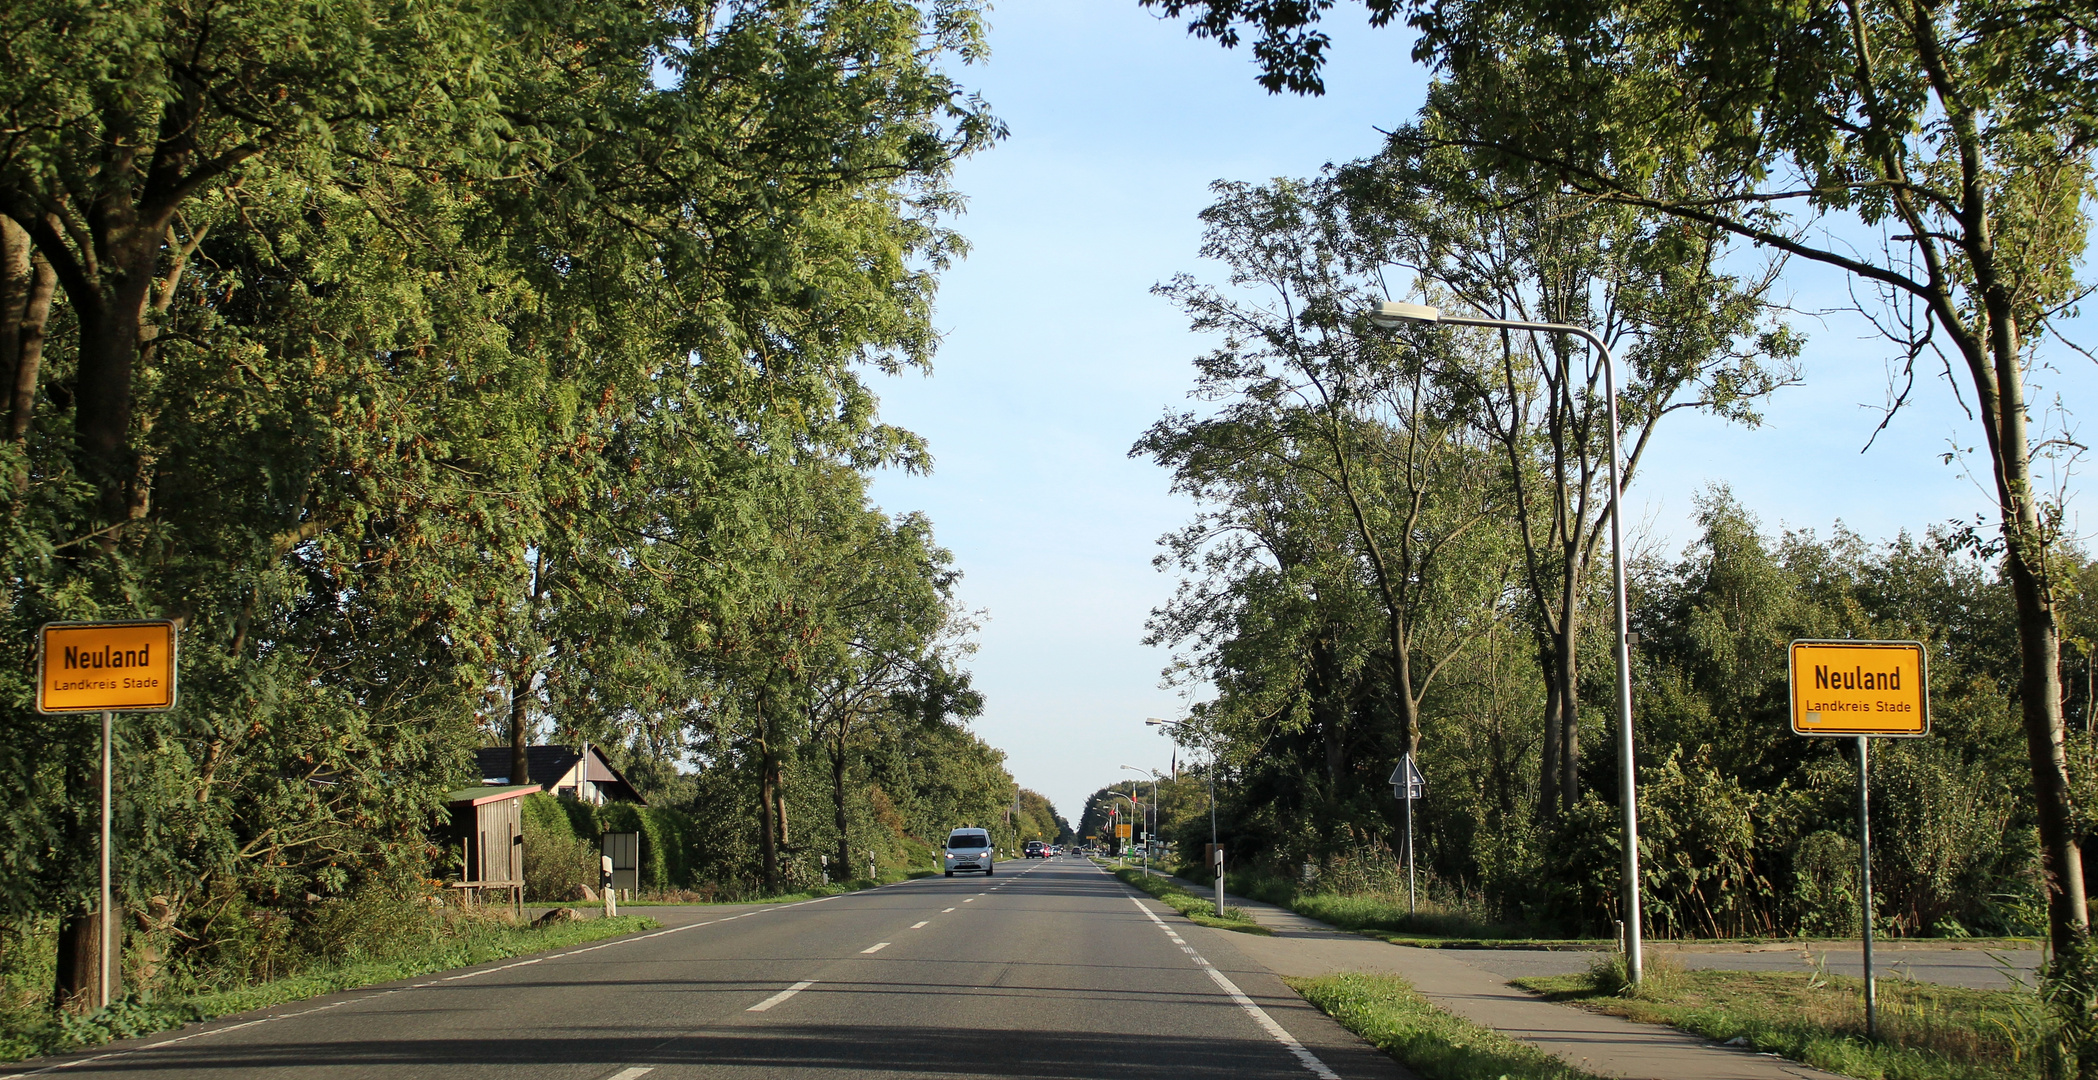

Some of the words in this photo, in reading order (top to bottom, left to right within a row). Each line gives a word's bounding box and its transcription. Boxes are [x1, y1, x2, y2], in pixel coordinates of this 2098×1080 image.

[64, 643, 150, 670] Neuland
[54, 679, 117, 691] Landkreis
[123, 677, 159, 689] Stade
[1815, 664, 1901, 691] Neuland
[1806, 700, 1870, 712] Landkreis
[1876, 700, 1911, 713] Stade
